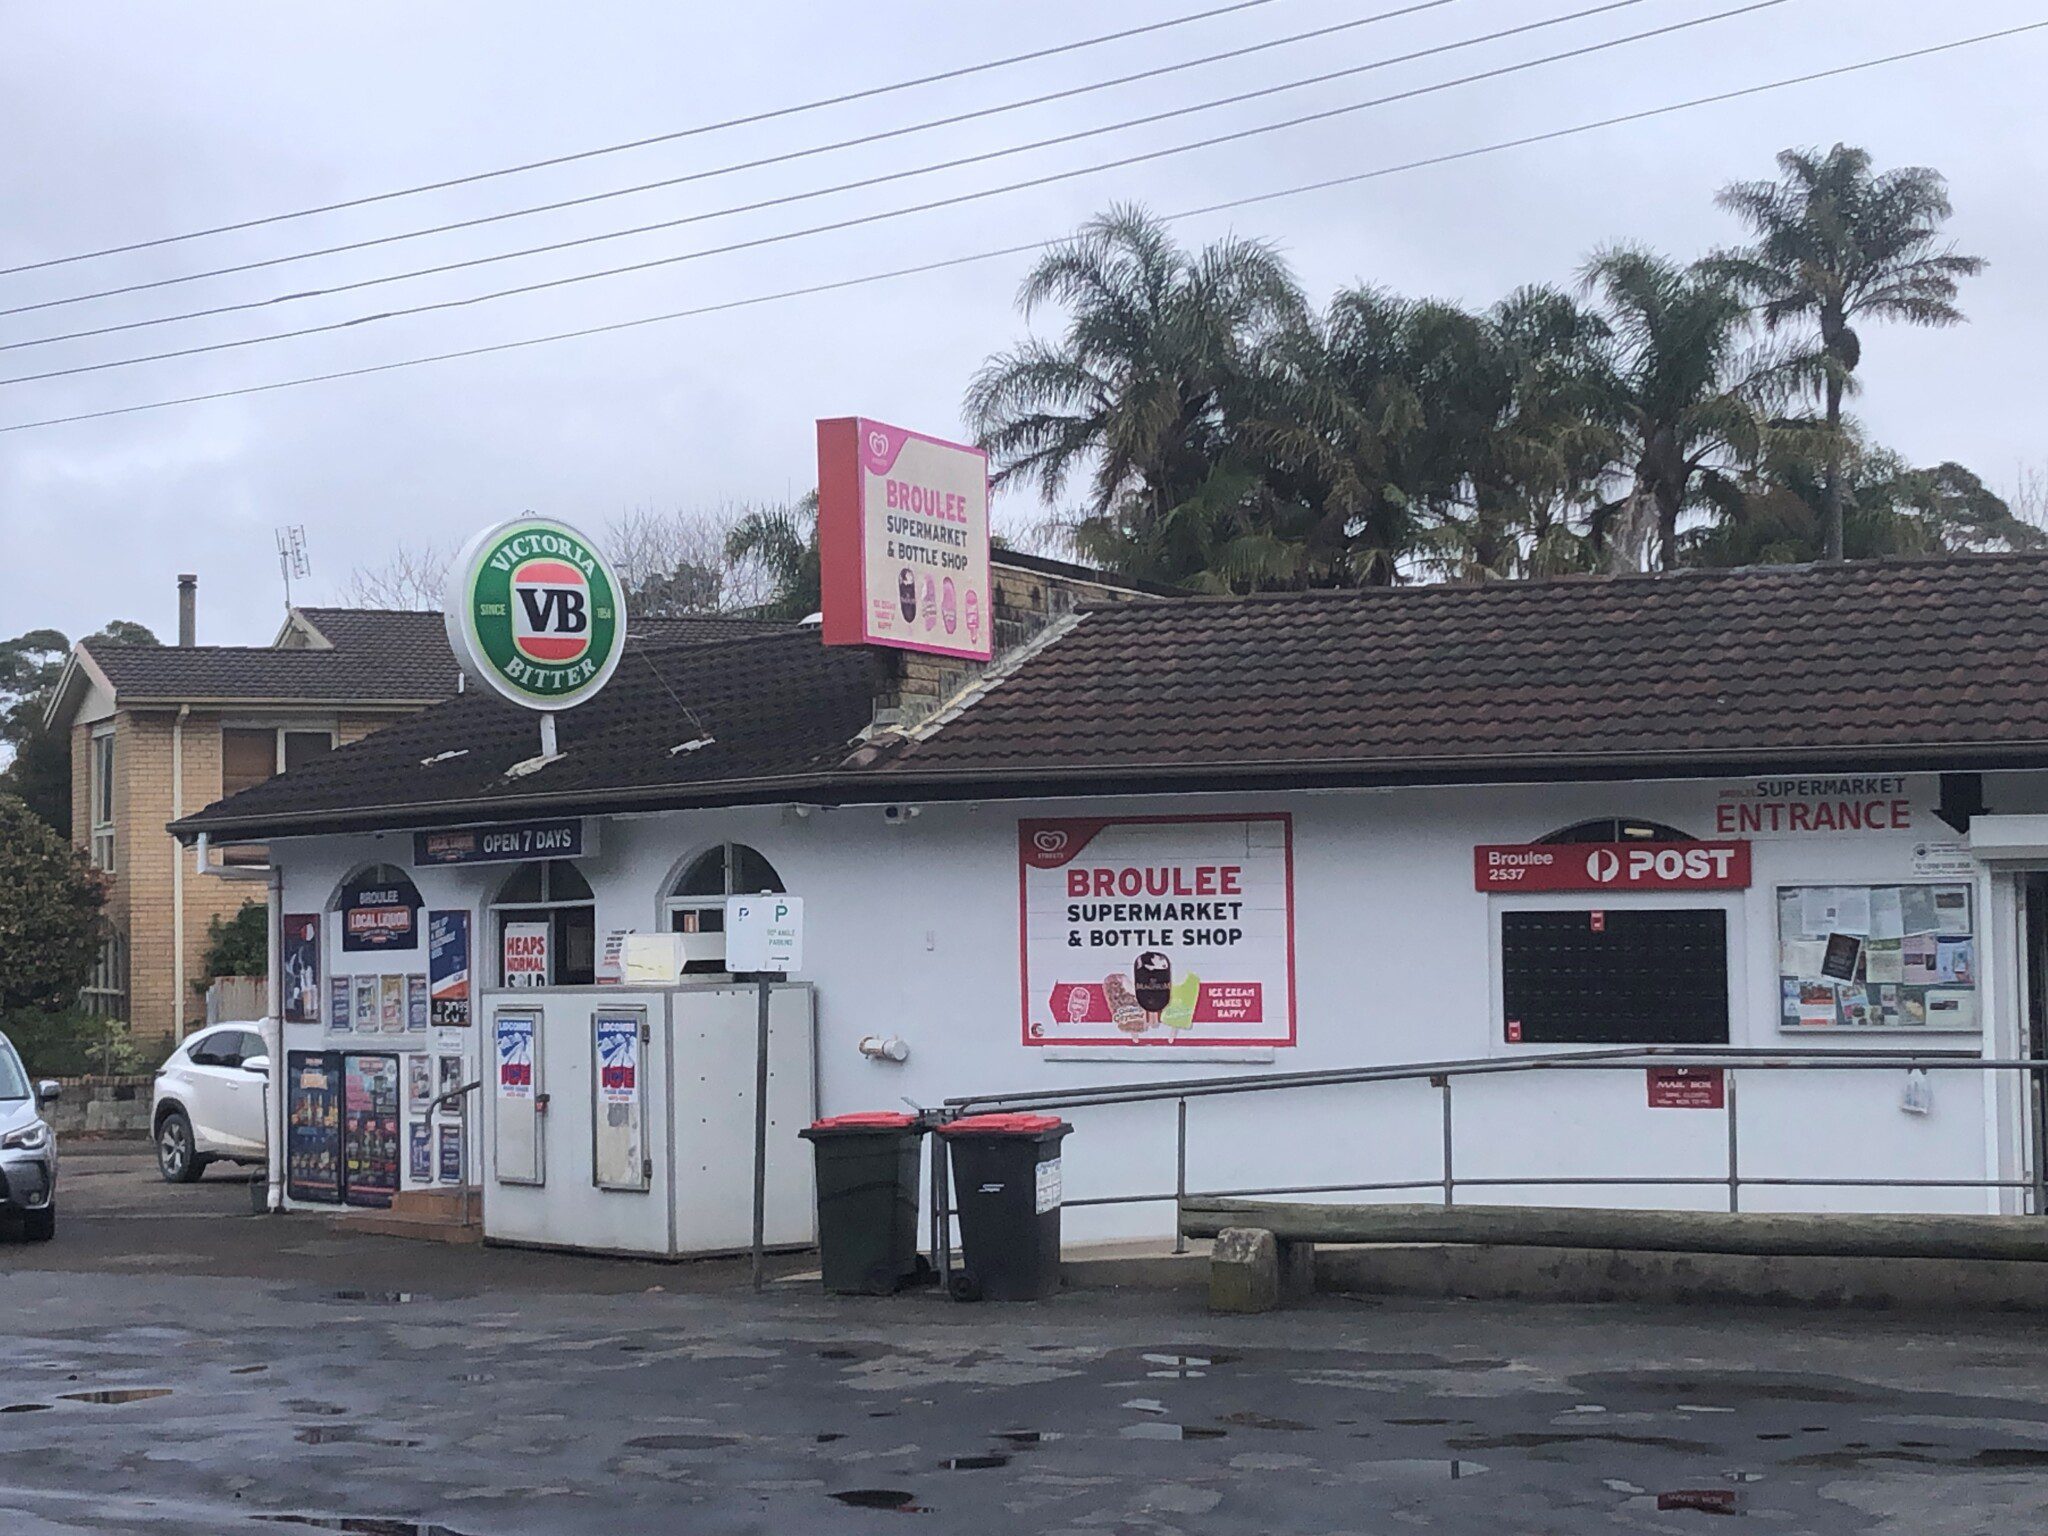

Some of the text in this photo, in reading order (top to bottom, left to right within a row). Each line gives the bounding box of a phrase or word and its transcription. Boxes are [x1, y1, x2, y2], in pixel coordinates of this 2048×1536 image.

[886, 479, 967, 524] BROULEE
[887, 515, 967, 548] SUPERMARKET
[490, 534, 597, 578] VICTORIA
[887, 541, 968, 571] & BOTTLE SHOP
[480, 604, 506, 616] SINCE
[515, 588, 587, 633] VB
[503, 655, 596, 689] BITTER
[1756, 778, 1906, 797] SUPERMARKET
[1716, 800, 1911, 833] ENTRANCE
[483, 832, 519, 853] OPEN
[523, 830, 532, 852] 7
[536, 828, 572, 849] DAYS
[1488, 849, 1735, 880] Broulee POST
[1489, 868, 1526, 881] 2537
[1067, 866, 1242, 897] BROULEE
[351, 911, 408, 928] LOCAL LIQUOR
[775, 905, 788, 922] P
[1067, 902, 1243, 922] SUPERMARKET
[507, 936, 545, 956] HEAPS
[1068, 928, 1243, 947] & BOTTLE SHOP
[507, 957, 545, 972] NORMAL
[1208, 988, 1255, 997] ICE CREAM
